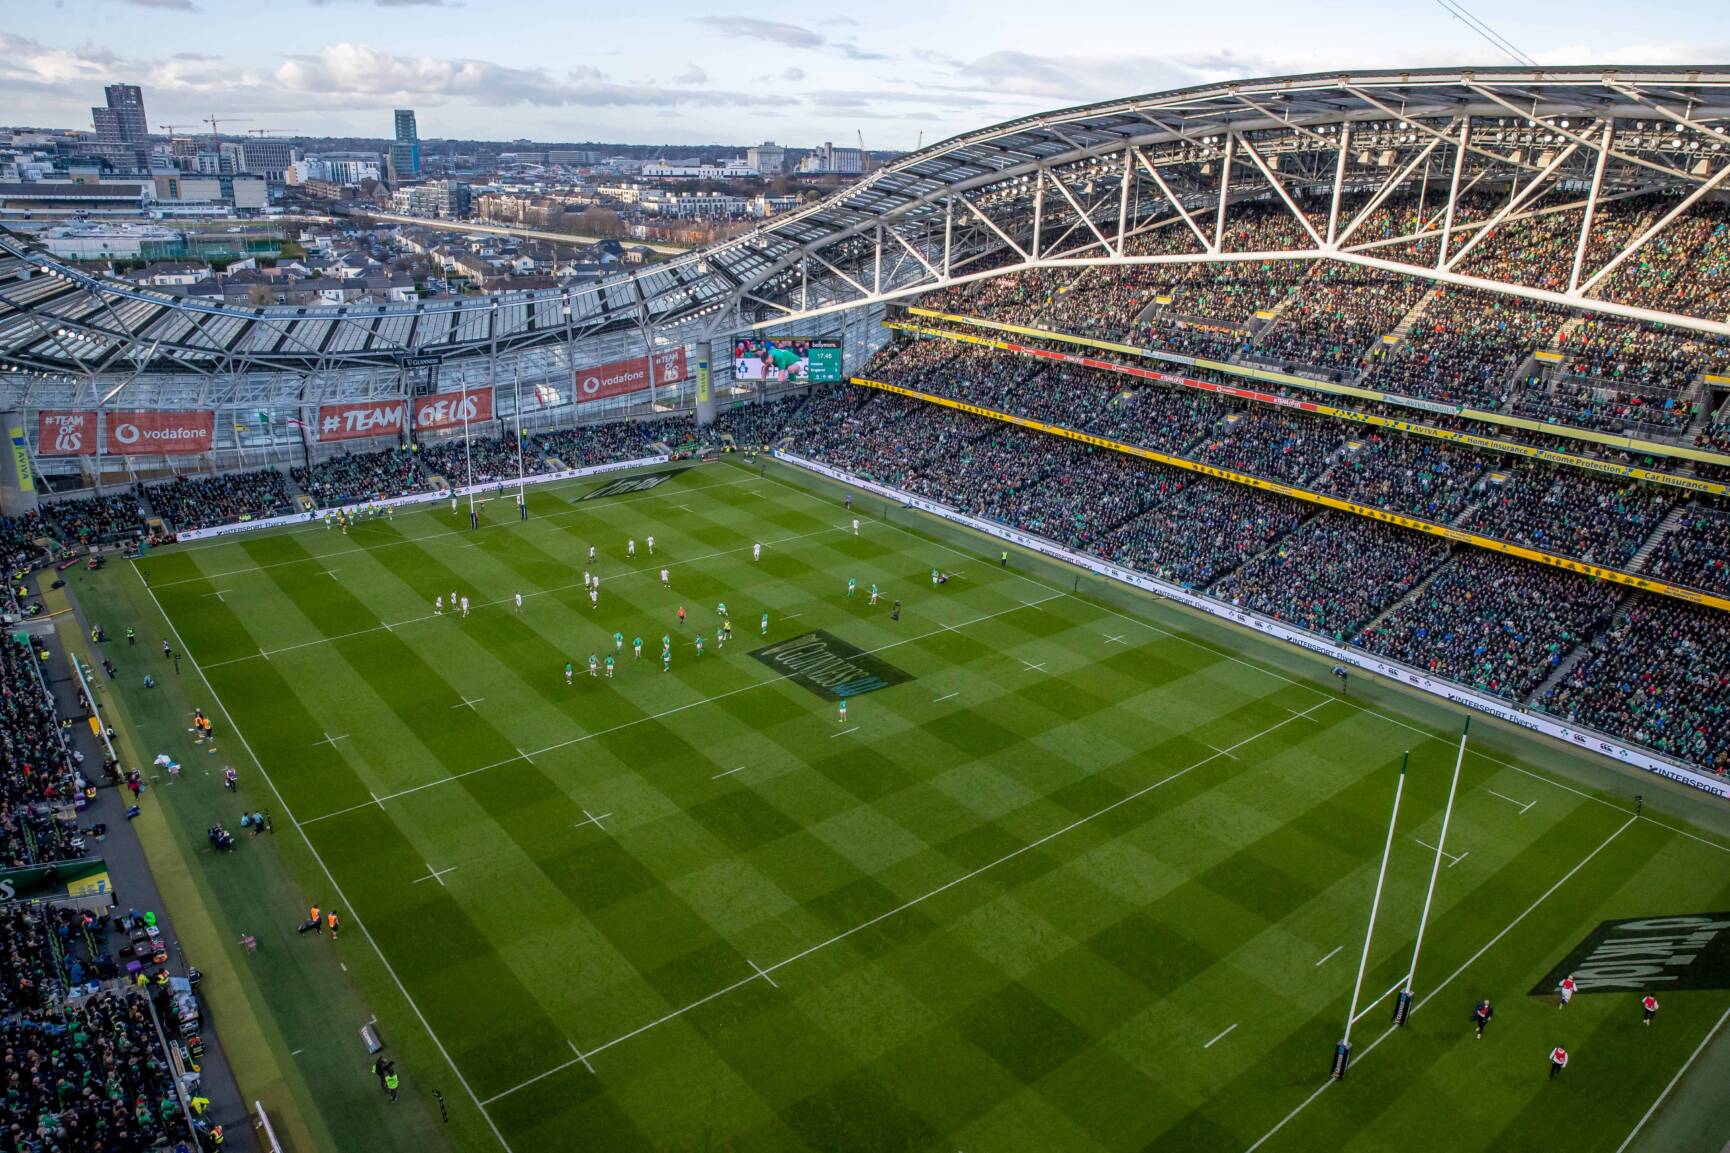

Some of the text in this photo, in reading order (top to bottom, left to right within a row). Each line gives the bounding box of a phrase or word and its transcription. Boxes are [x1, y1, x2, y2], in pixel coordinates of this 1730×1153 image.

[655, 353, 679, 365] #TEAM
[664, 361, 673, 370] OF
[601, 369, 645, 386] vodafone
[663, 367, 679, 382] US
[44, 415, 84, 427] #TEAM
[322, 405, 402, 434] #TEAM
[59, 424, 75, 434] OF
[143, 427, 207, 440] vodafone
[55, 432, 82, 450] US
[17, 451, 29, 480] AVIVA
[1412, 425, 1709, 490] AVIVA Home Insurance Income Protection Car Insurance
[222, 523, 263, 535] INTERSPORT
[1157, 588, 1194, 606] INTERSPORT
[1292, 637, 1361, 667] INTERSPORT Elverys
[775, 642, 870, 687] GUINNESS
[1455, 694, 1539, 731] INTERSPORT Elverys
[1658, 767, 1727, 798] INTERSPORT
